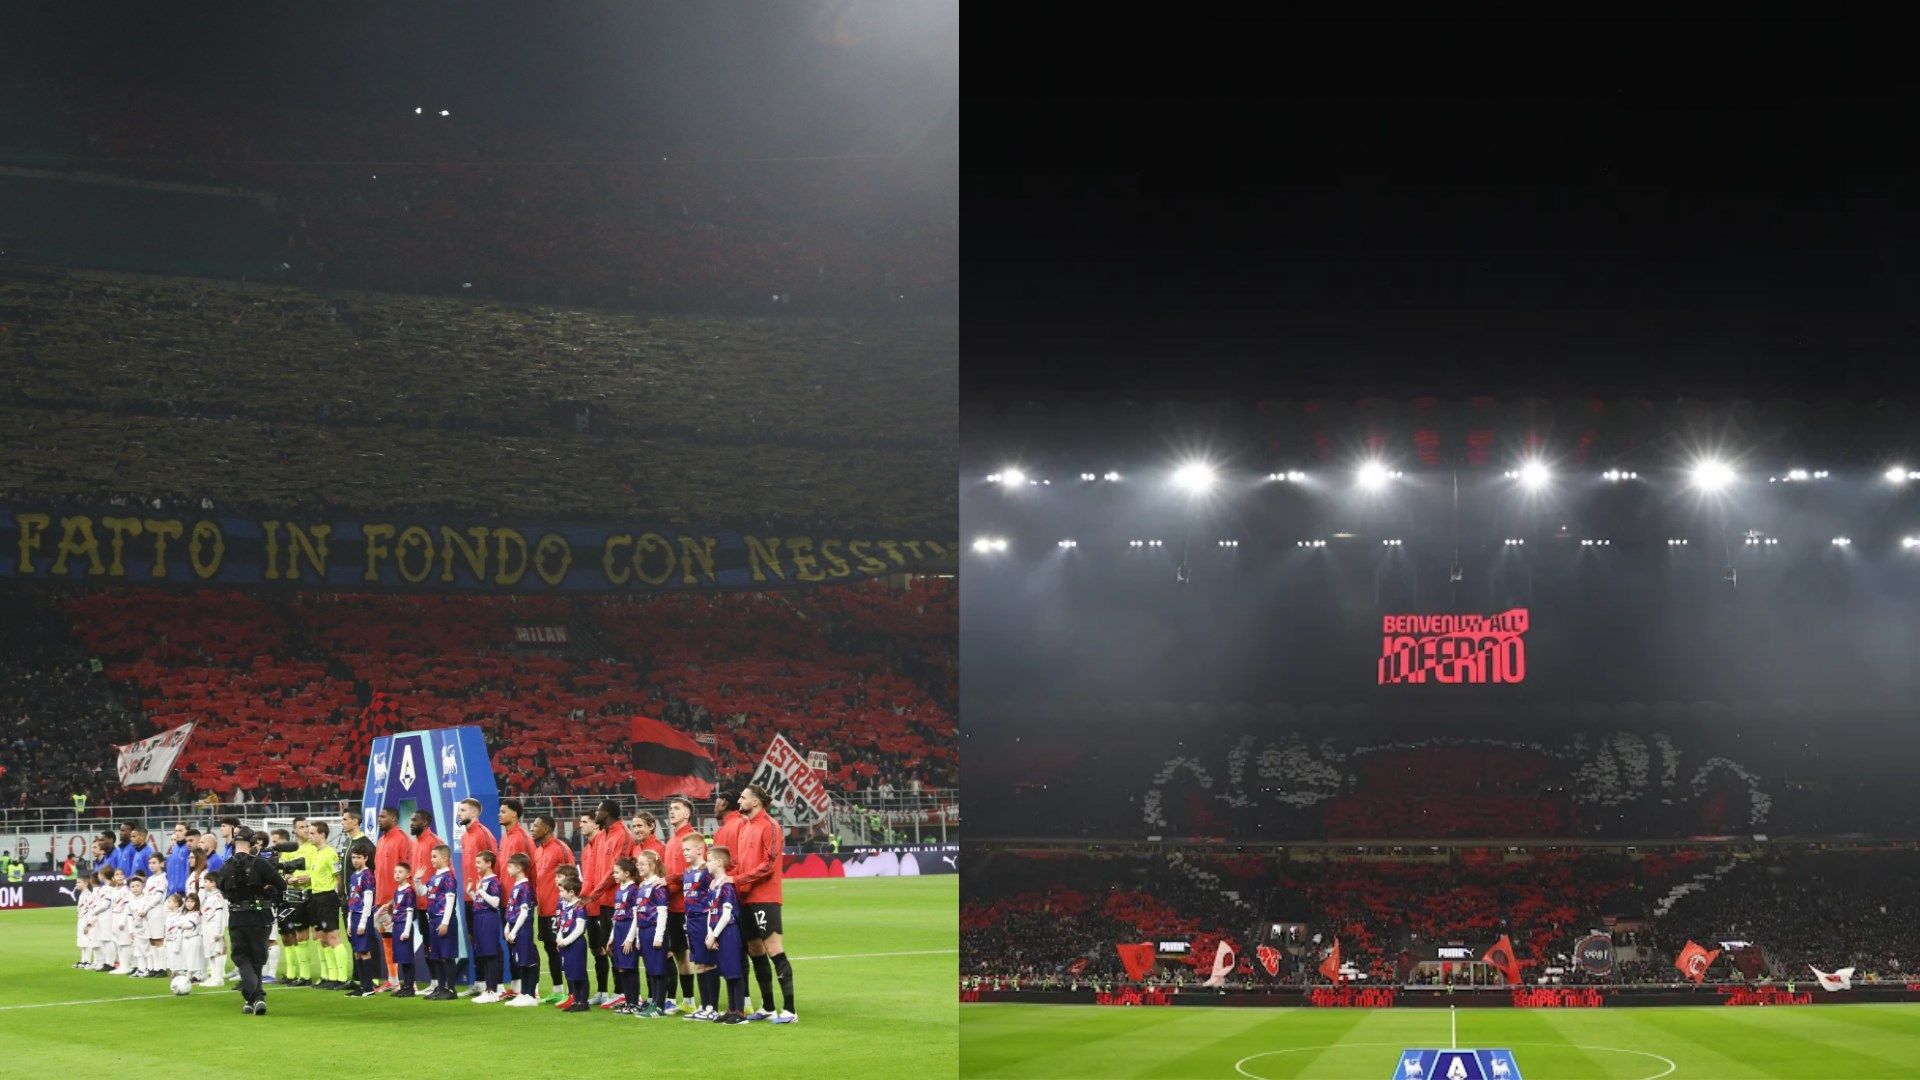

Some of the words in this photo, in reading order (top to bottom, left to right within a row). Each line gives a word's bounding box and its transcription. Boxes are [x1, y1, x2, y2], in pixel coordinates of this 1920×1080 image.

[16, 512, 225, 578] FATTO
[262, 519, 331, 579] IN
[361, 523, 573, 586] FONDO
[602, 531, 718, 585] CON
[515, 626, 567, 642] MILAN
[1383, 614, 1483, 634] BENVENUTI
[1377, 635, 1525, 685] INFERNO
[753, 909, 768, 925] 12
